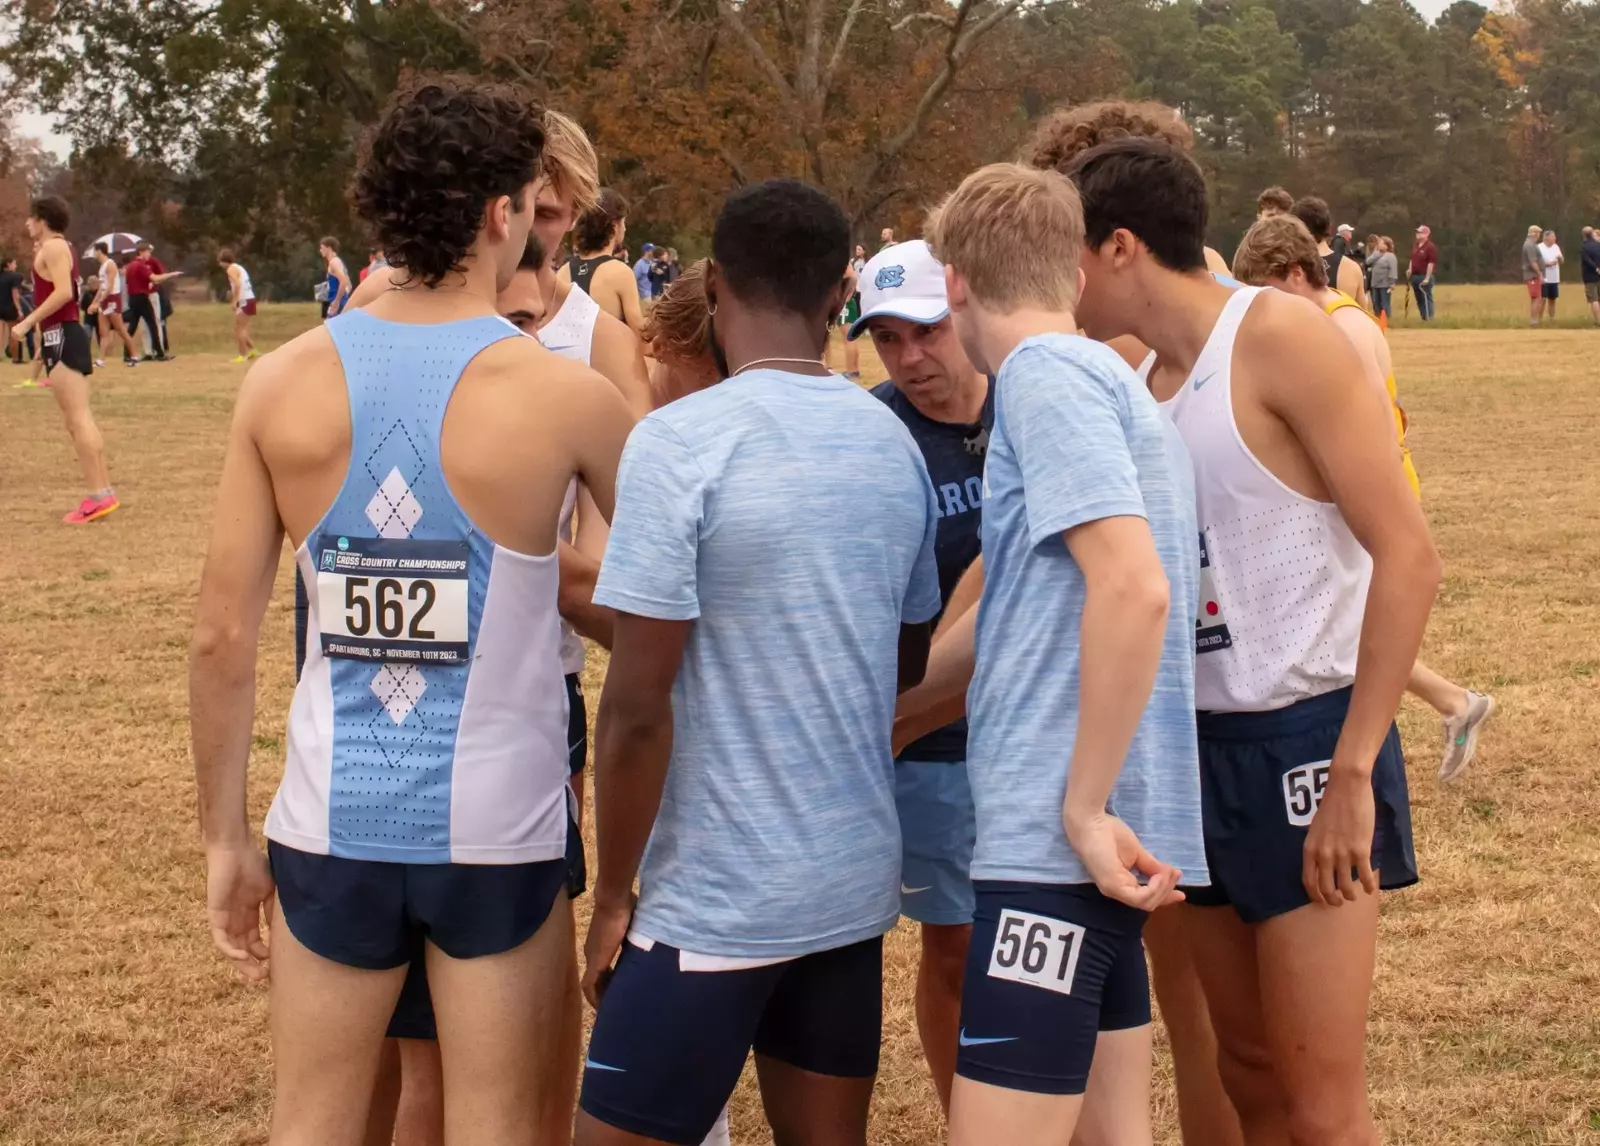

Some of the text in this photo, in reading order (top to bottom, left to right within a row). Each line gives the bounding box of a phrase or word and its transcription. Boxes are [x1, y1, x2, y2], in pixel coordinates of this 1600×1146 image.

[336, 555, 360, 566] CROSS
[360, 557, 398, 568] COUNTRY
[398, 559, 466, 570] CHAMPIONSHIPS
[345, 576, 436, 639] 562
[328, 643, 372, 658] SPARTANBURG,
[372, 648, 382, 657] SC
[386, 648, 420, 659] NOVEMBER
[422, 650, 439, 660] 10TH
[439, 650, 458, 660] 2023
[996, 916, 1075, 981] 561
